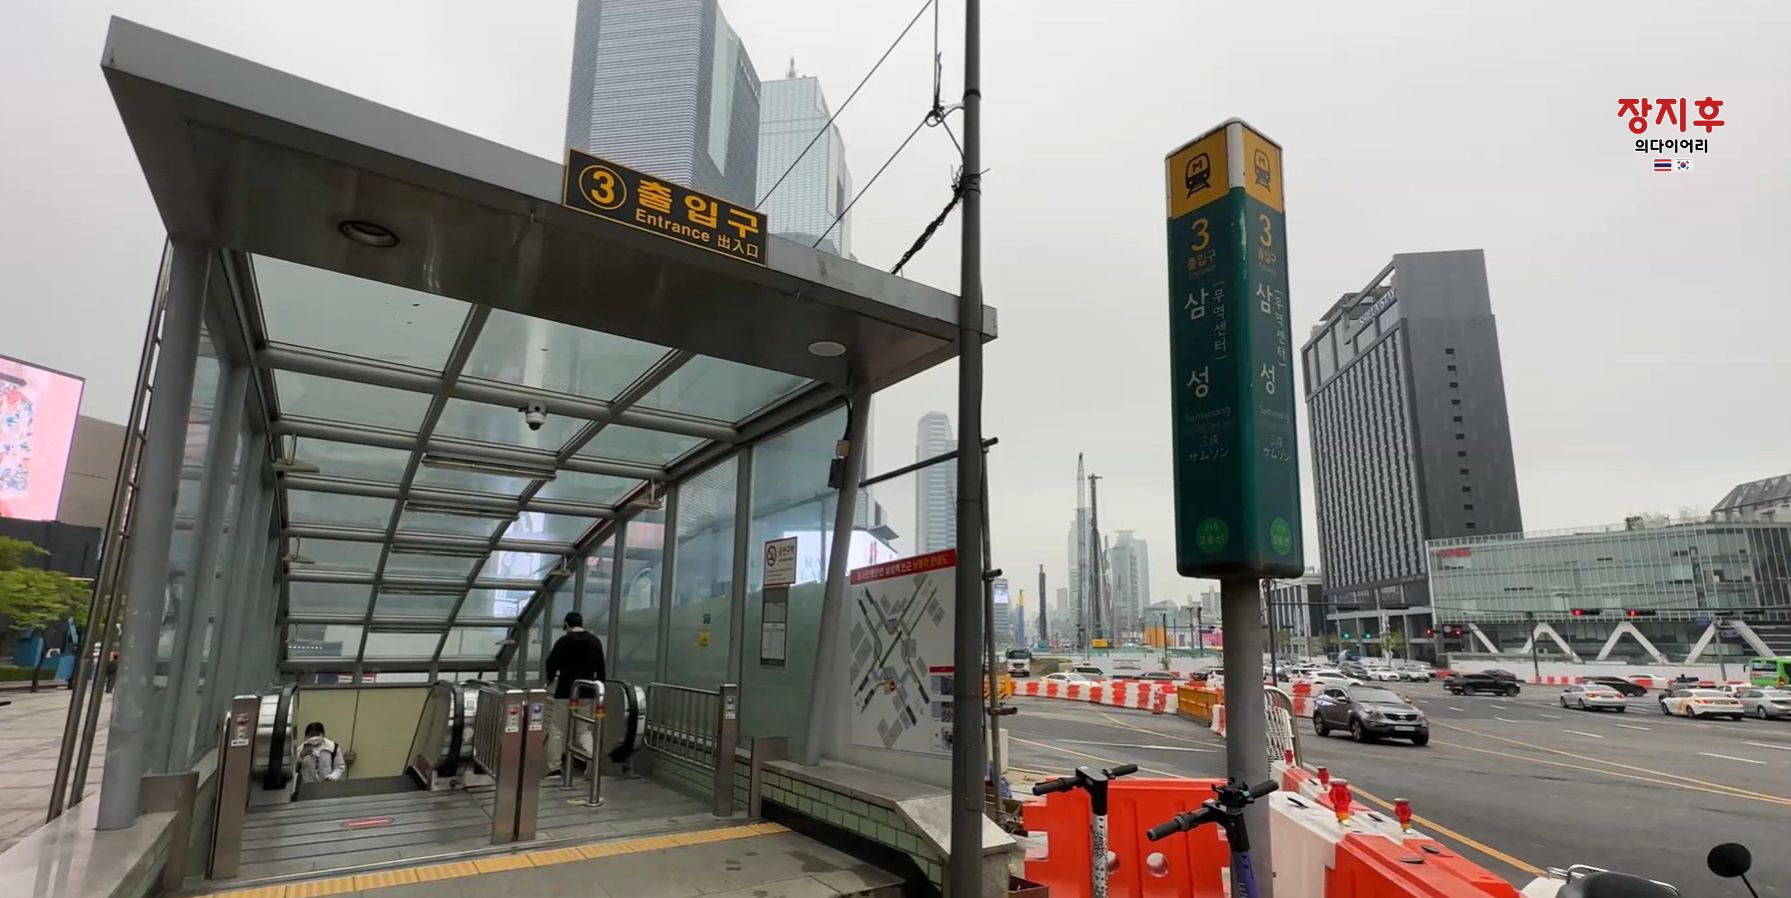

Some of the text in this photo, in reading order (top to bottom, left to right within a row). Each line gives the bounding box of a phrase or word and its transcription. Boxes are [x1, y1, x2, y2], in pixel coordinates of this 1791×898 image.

[638, 179, 760, 238] 출입구
[636, 208, 759, 258] Entrance 出入口
[1191, 217, 1210, 252] 3
[1258, 213, 1272, 247] 3
